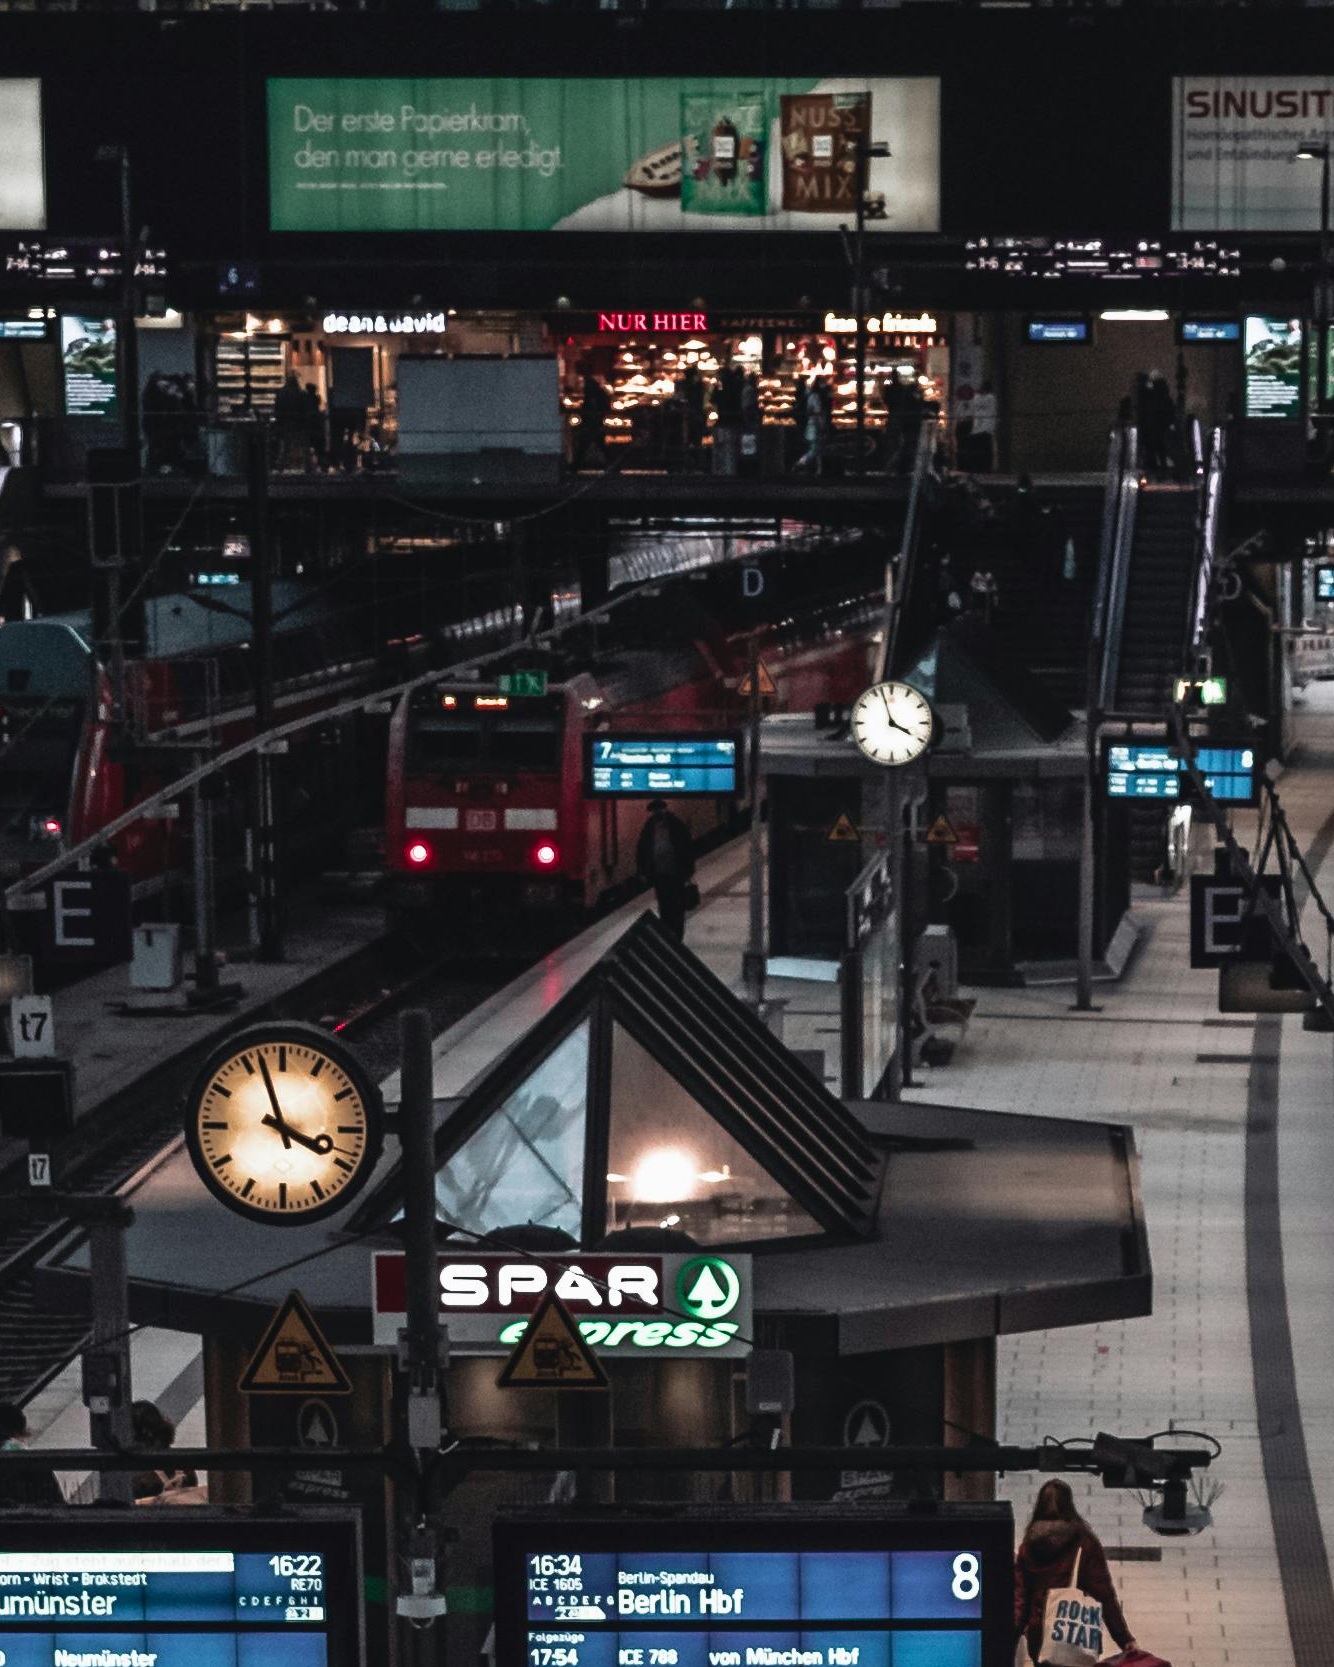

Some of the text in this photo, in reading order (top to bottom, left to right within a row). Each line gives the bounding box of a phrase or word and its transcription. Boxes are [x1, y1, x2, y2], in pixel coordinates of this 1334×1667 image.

[294, 105, 334, 132] Der
[341, 110, 396, 133] erste
[789, 106, 856, 128] NUSS
[294, 139, 339, 168] den
[345, 150, 396, 168] man
[402, 149, 470, 176] gerne
[797, 174, 852, 200] MIX
[599, 313, 707, 331] NUR HIER
[742, 567, 764, 597] D
[53, 880, 95, 946] E
[1204, 886, 1244, 953] E
[19, 1012, 48, 1042] t7
[32, 1158, 47, 1180] t7
[439, 1263, 659, 1307] SPAR
[499, 1321, 740, 1348] epress
[268, 1555, 322, 1576] 16:22
[530, 1554, 583, 1576] 16:34
[951, 1552, 980, 1600] 8
[33, 1572, 68, 1586] Wrist
[81, 1572, 147, 1586] Brokstedt
[290, 1578, 323, 1591] RE70
[529, 1577, 583, 1591] ICE 1605
[618, 1571, 715, 1586] Berlin-Spandau
[238, 1595, 247, 1606] C
[251, 1595, 260, 1606] D
[263, 1595, 271, 1606] E
[275, 1595, 283, 1606] F
[532, 1595, 542, 1606] A
[545, 1595, 553, 1606] B
[557, 1595, 565, 1606] C
[569, 1595, 578, 1606] D
[582, 1595, 590, 1606] E
[594, 1595, 601, 1606] F
[618, 1588, 691, 1615] Berlin
[699, 1588, 744, 1615] Hbf
[1056, 1600, 1102, 1627] ROCK
[528, 1632, 585, 1645] Folgezüge
[1051, 1618, 1103, 1650] STAR
[54, 1649, 157, 1667] Neumünster
[530, 1647, 860, 1667] 17:54 ICE 788 von München Hbf
